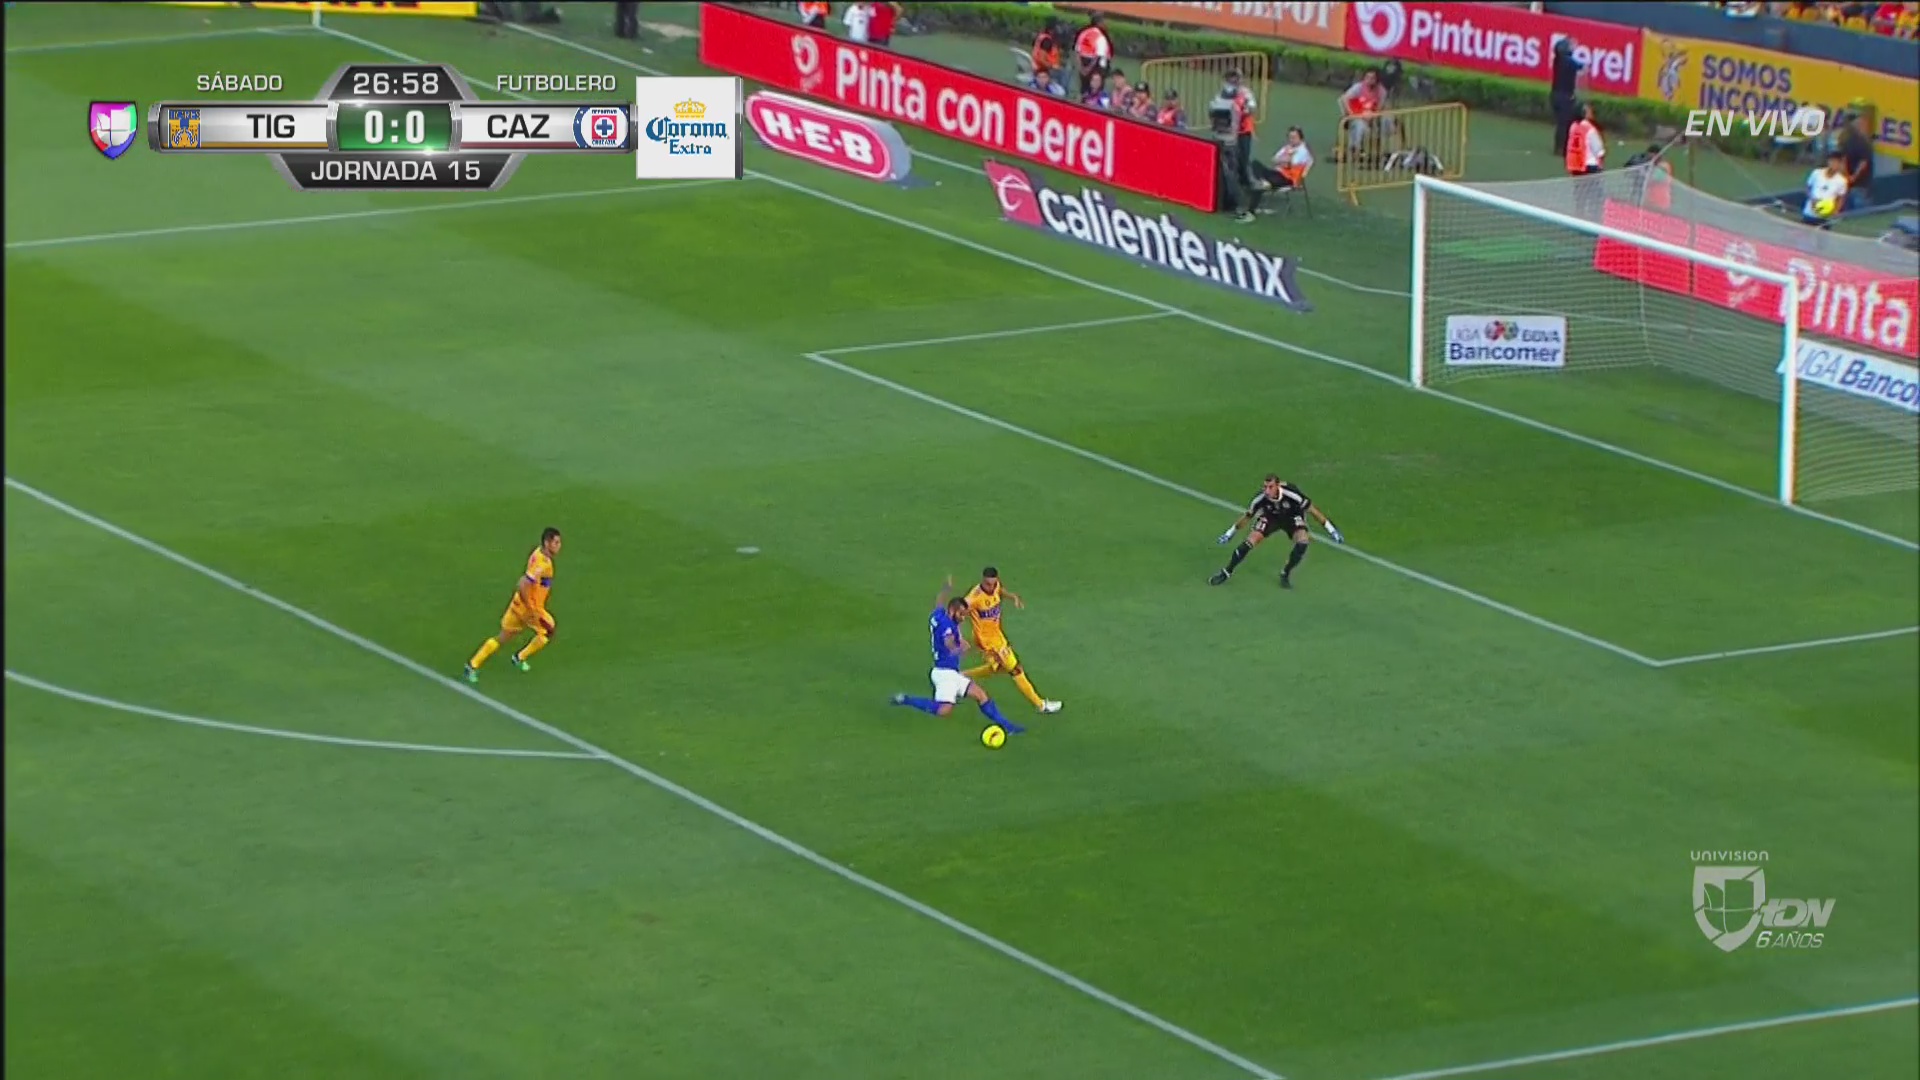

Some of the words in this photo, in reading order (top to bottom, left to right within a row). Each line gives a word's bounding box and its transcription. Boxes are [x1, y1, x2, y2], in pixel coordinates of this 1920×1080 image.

[1410, 10, 1540, 68] Pinturas
[1702, 54, 1792, 93] SOMOS
[835, 47, 927, 122] Pinta
[936, 88, 1005, 146] con
[1015, 97, 1115, 178] Berel
[1037, 186, 1293, 302] caliente.mx
[1779, 258, 1911, 349] Pinta
[1449, 343, 1560, 361] Bancomer
[1840, 358, 1919, 406] Banco
